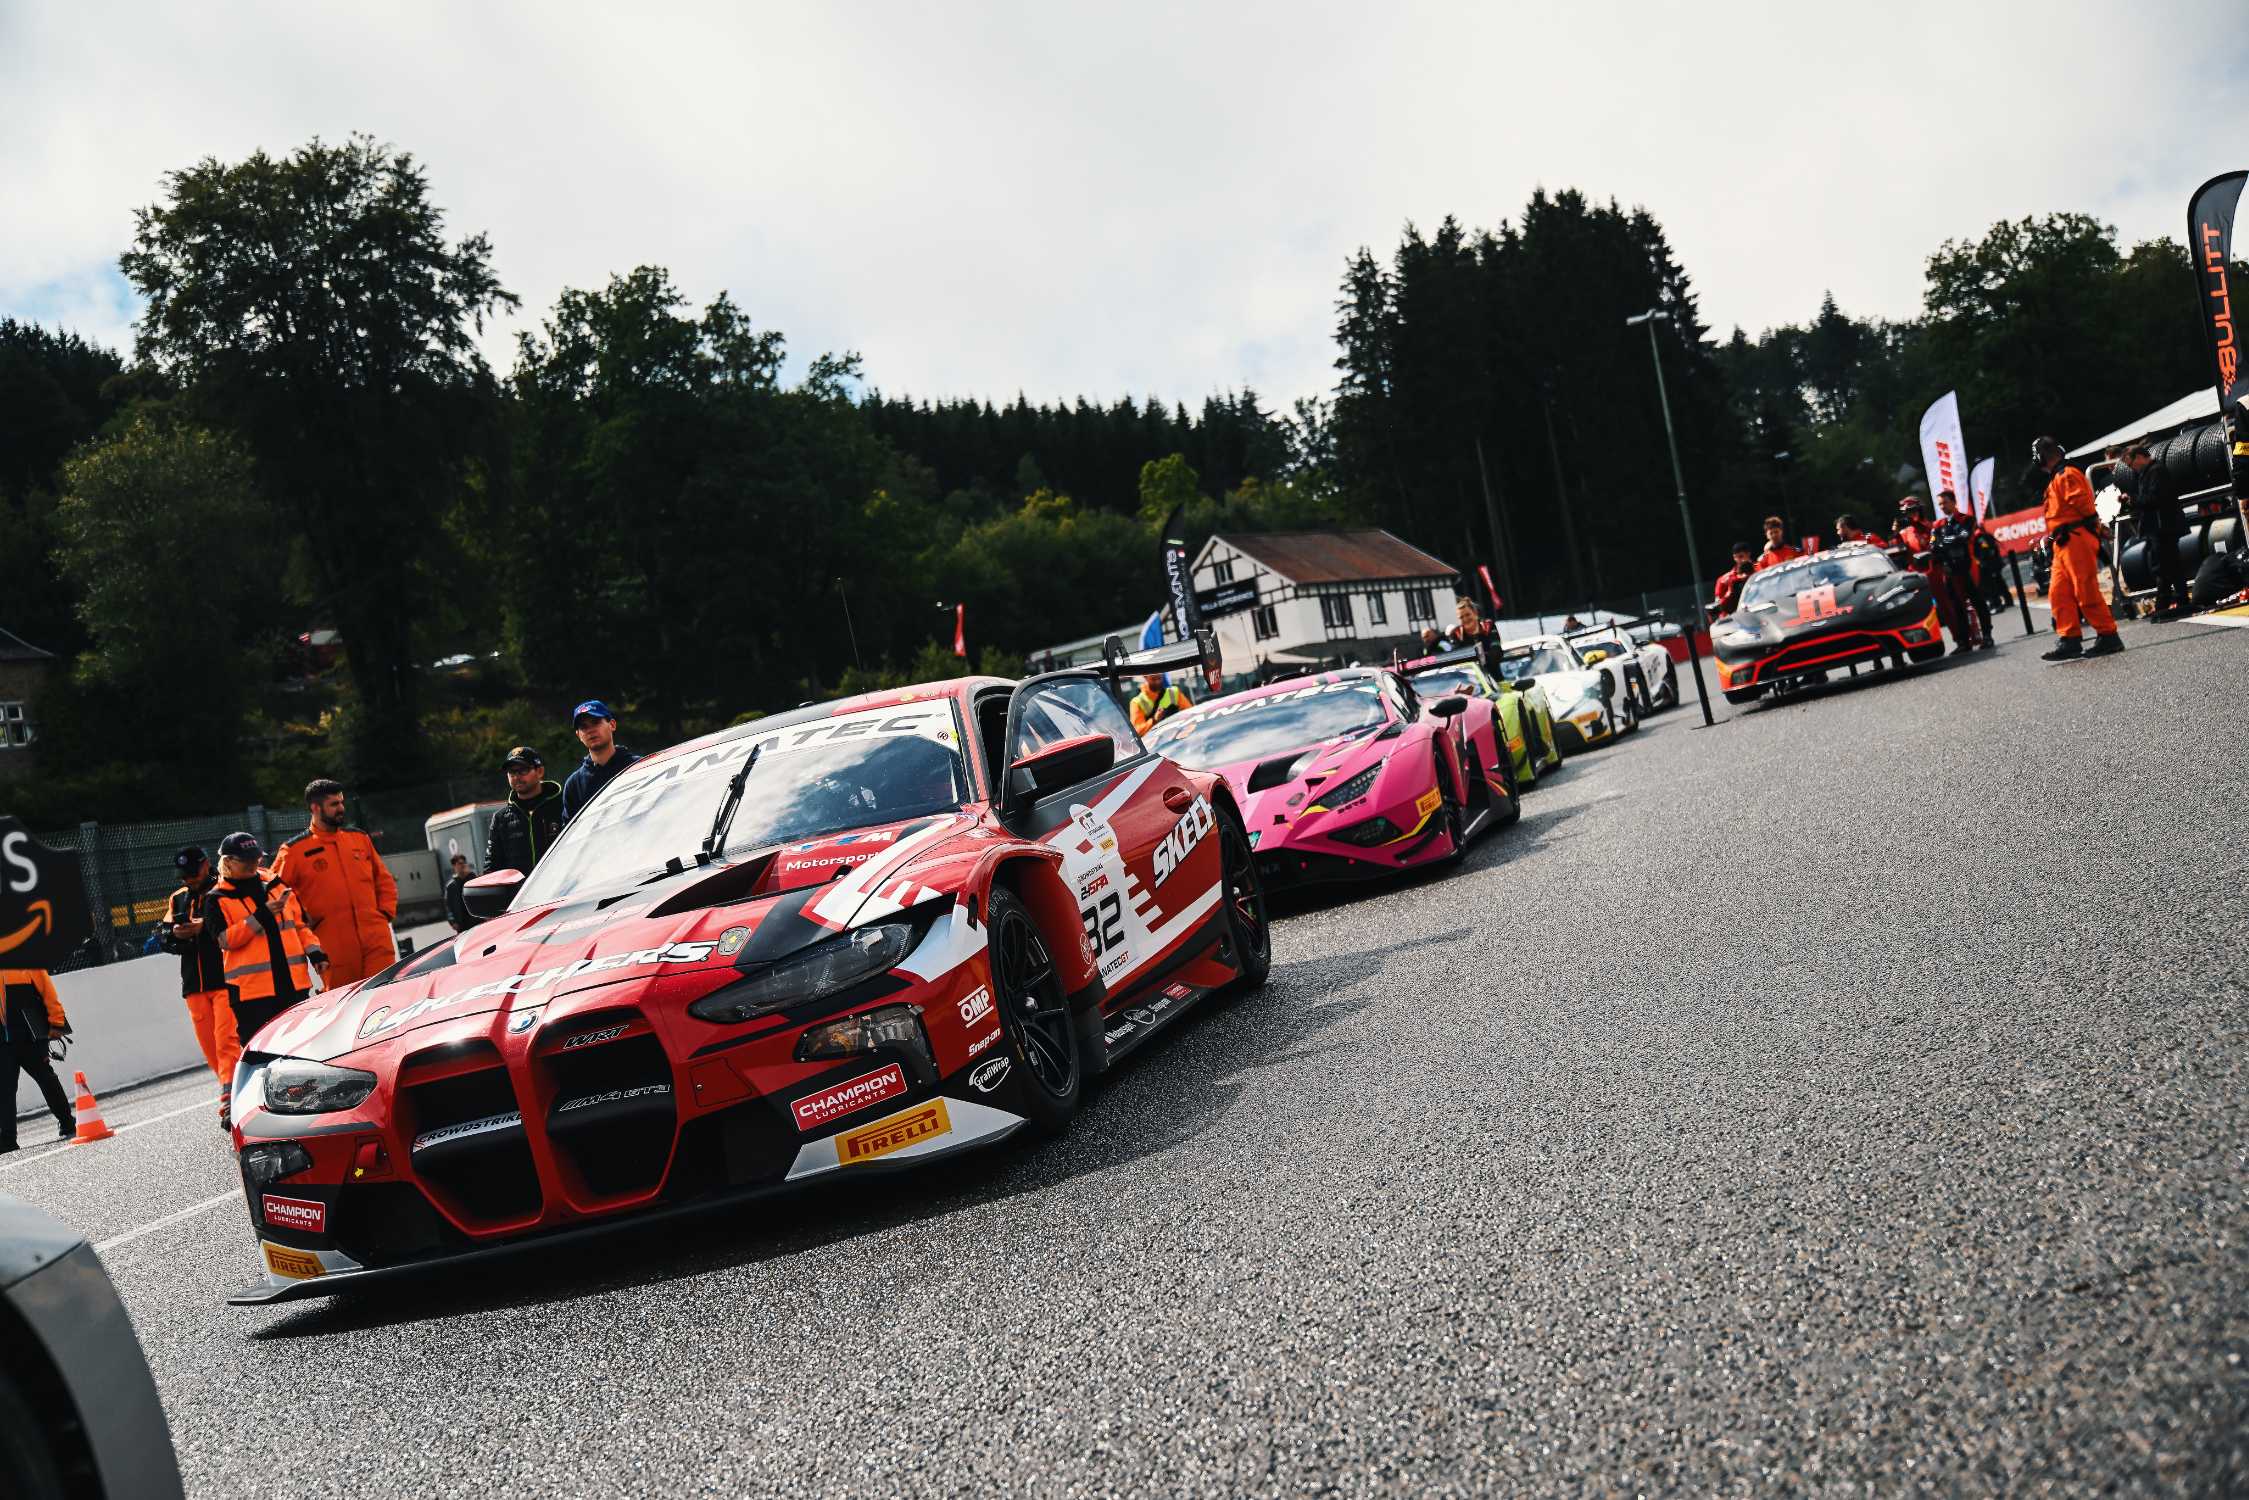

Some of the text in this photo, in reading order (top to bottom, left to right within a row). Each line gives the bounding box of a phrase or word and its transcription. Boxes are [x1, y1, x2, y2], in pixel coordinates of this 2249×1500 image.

[2202, 222, 2238, 386] BULLITT
[603, 713, 933, 803] FANATEC
[786, 852, 880, 871] Motorsport
[373, 940, 718, 1034] SKECHERS
[960, 989, 990, 1022] OMP
[563, 1024, 630, 1050] WRT
[968, 1027, 1001, 1057] Snap-on
[973, 1056, 1010, 1088] GrafiWrap
[799, 1071, 897, 1118] CHAMPION
[816, 1089, 886, 1120] LUBRICANTS
[848, 1109, 939, 1158] PIRELLI
[267, 1202, 321, 1220] CHAMPION
[274, 1215, 312, 1227] LUBRICANTS
[268, 1249, 324, 1276] PIRELLI
